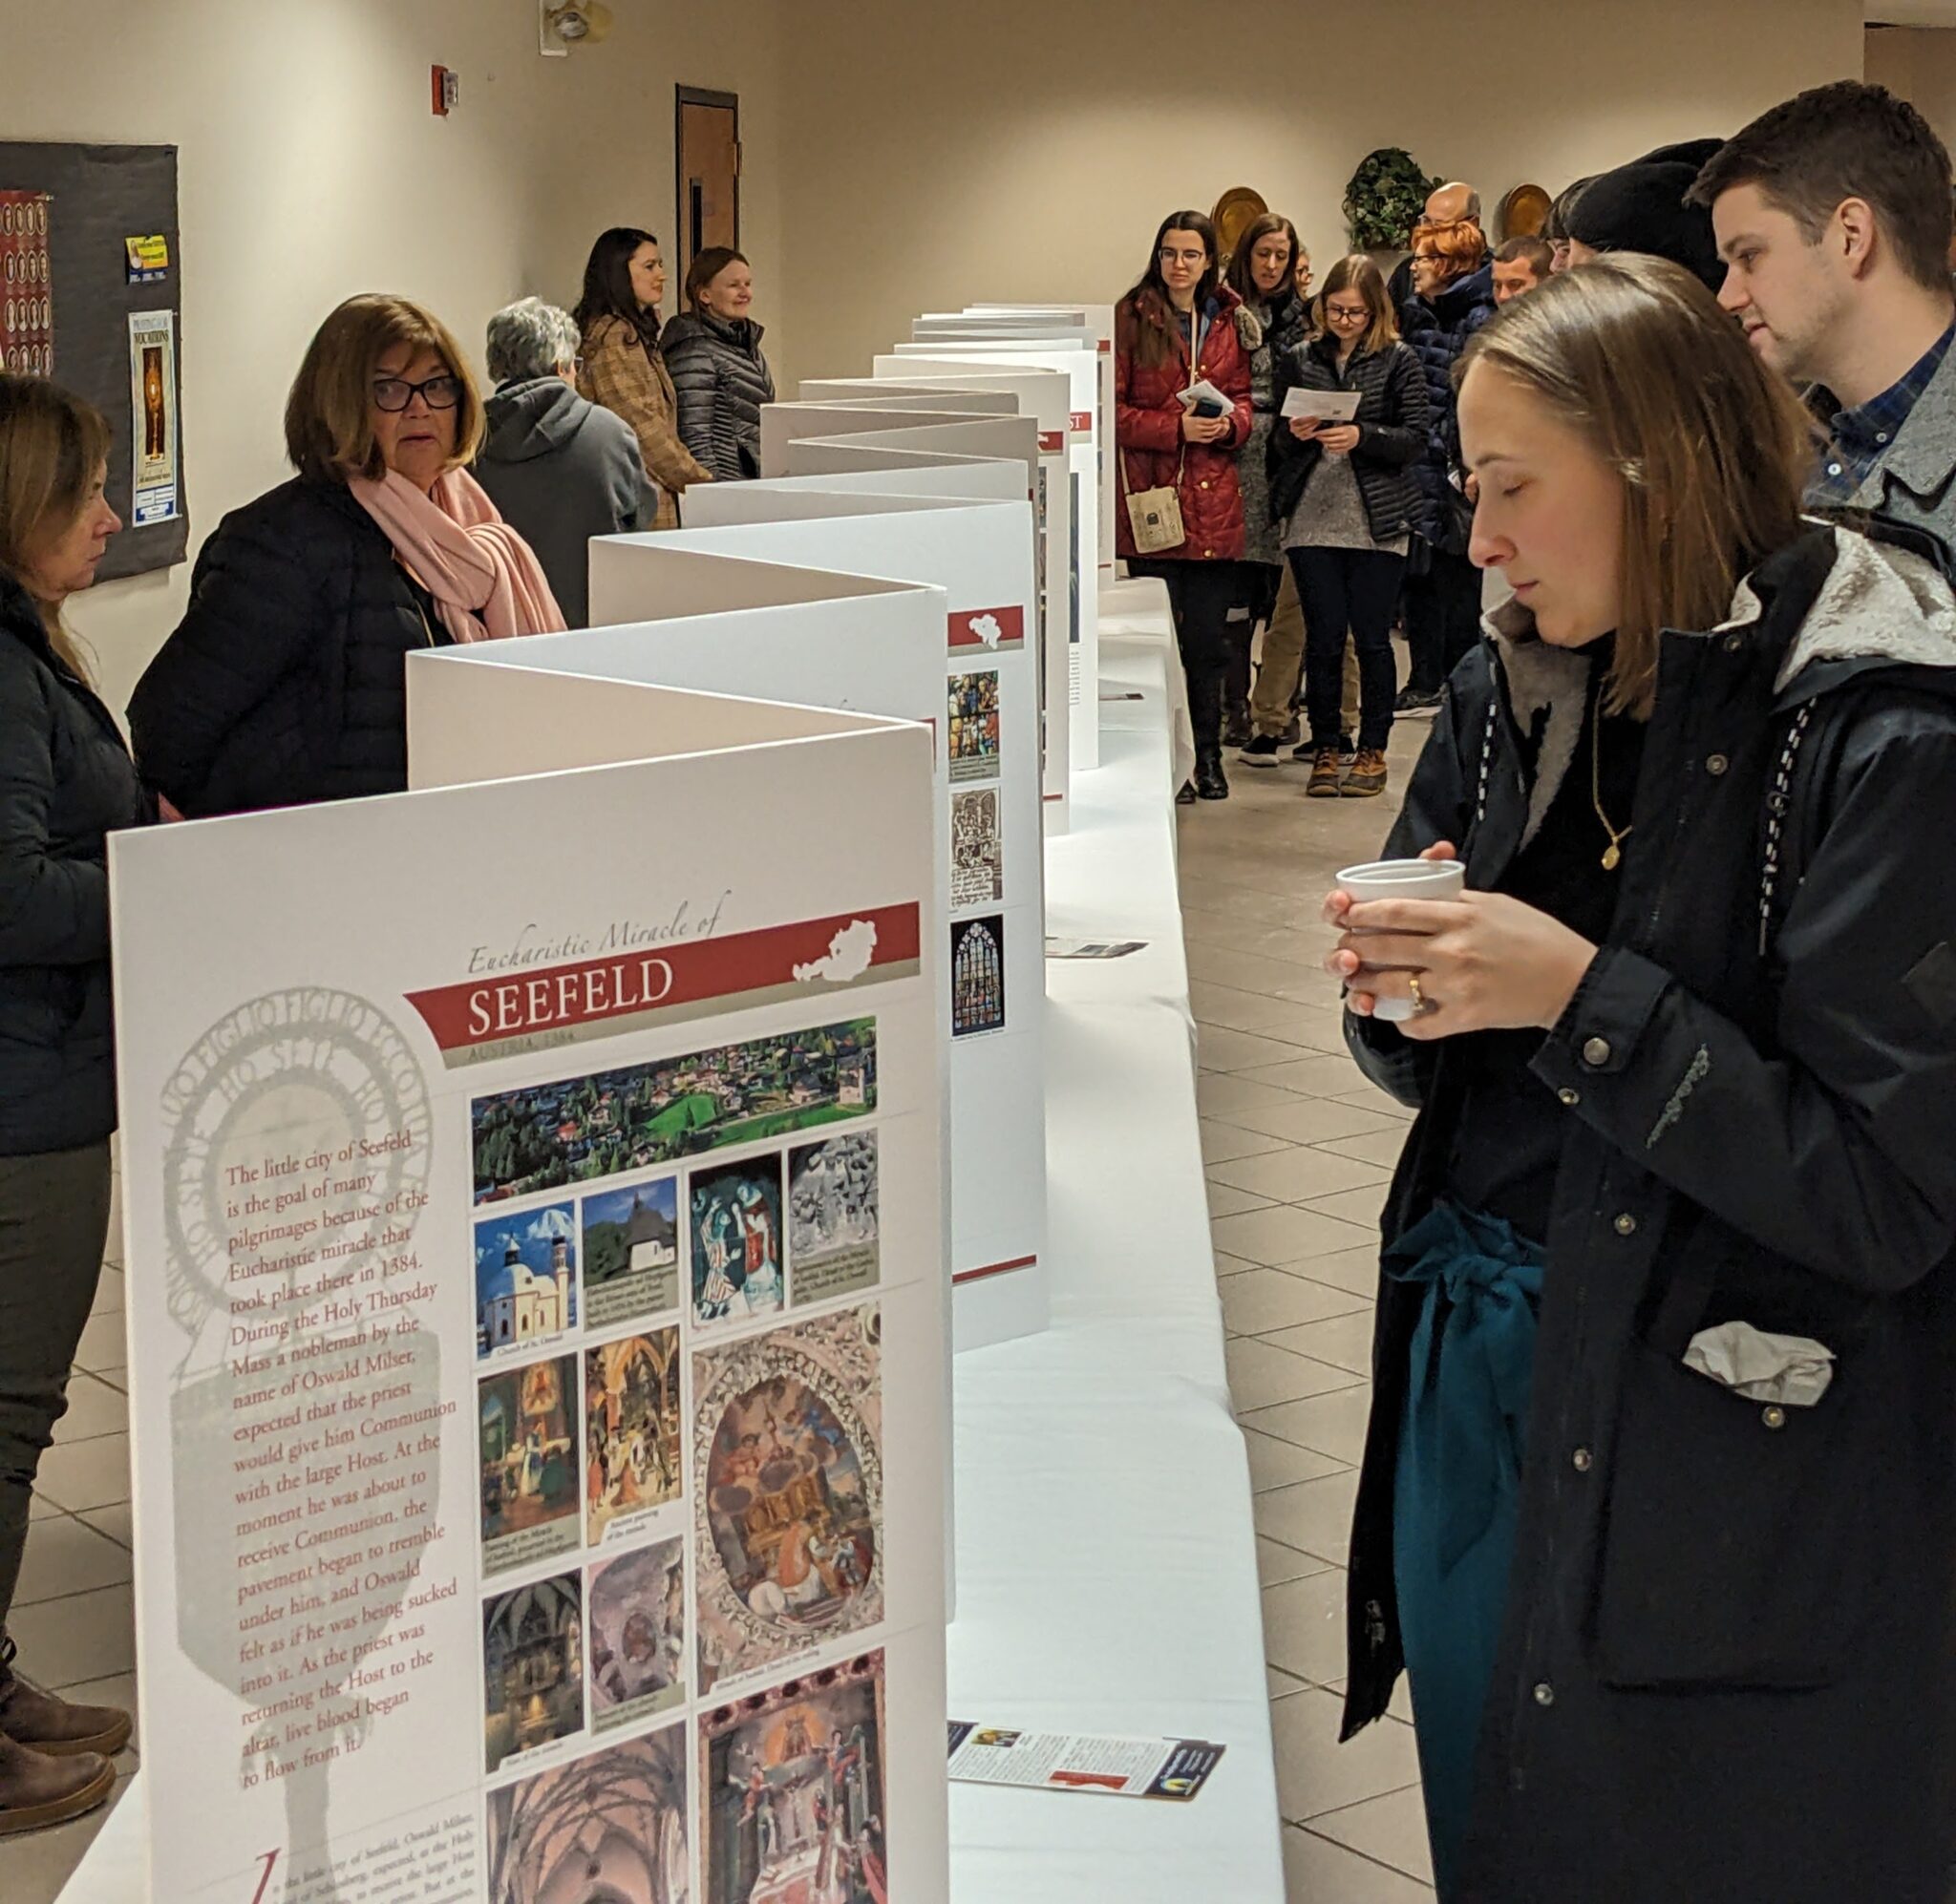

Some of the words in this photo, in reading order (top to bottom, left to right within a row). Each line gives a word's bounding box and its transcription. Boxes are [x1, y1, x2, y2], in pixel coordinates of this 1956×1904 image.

[467, 922, 590, 975] Eucharistic
[599, 899, 689, 955] Miracle
[697, 889, 733, 937] of
[467, 958, 673, 1036] SEEFELD
[225, 1165, 259, 1186] The
[265, 1154, 300, 1179] little
[306, 1149, 332, 1171] city
[338, 1141, 356, 1161] of
[358, 1130, 412, 1158] Seefeld
[227, 1200, 239, 1218] is
[244, 1194, 271, 1215] the
[275, 1183, 307, 1214] goal
[312, 1177, 331, 1199] of
[333, 1174, 376, 1194] many
[228, 1218, 317, 1256] pilgrimages
[323, 1201, 381, 1229] because
[385, 1191, 404, 1215] of
[406, 1189, 429, 1210] the
[229, 1248, 315, 1282] Eucharistic
[321, 1233, 376, 1260] miracle
[382, 1225, 412, 1244] that
[230, 1289, 266, 1315] took
[271, 1282, 311, 1310] place
[316, 1272, 354, 1293] there
[360, 1265, 374, 1282] in
[231, 1319, 289, 1346] During
[294, 1308, 319, 1331] the
[324, 1299, 363, 1323] Holy
[366, 1280, 438, 1313] Thursday
[232, 1356, 271, 1378] Mass
[277, 1354, 285, 1366] a
[290, 1332, 367, 1364] nobleman
[372, 1322, 391, 1344] by
[395, 1315, 419, 1335] the
[233, 1389, 275, 1410] name
[281, 1374, 300, 1395] of
[302, 1359, 360, 1390] Oswald
[233, 1406, 301, 1443] expected
[307, 1400, 337, 1422] that
[343, 1390, 366, 1412] the
[371, 1381, 413, 1409] priest
[233, 1442, 284, 1472] would
[288, 1434, 320, 1464] give
[324, 1428, 355, 1449] him
[360, 1400, 457, 1438] Communion
[235, 1483, 270, 1505] with
[276, 1472, 301, 1493] the
[306, 1463, 342, 1486] large
[393, 1440, 412, 1460] At
[417, 1432, 441, 1454] the
[236, 1506, 303, 1536] moment
[308, 1496, 326, 1515] he
[331, 1490, 359, 1508] was
[364, 1477, 406, 1500] about
[411, 1470, 427, 1487] to
[237, 1542, 290, 1568] receive
[404, 1497, 428, 1518] the
[237, 1565, 313, 1606] pavement
[318, 1549, 363, 1575] began
[368, 1541, 383, 1558] to
[389, 1521, 446, 1554] tremble
[239, 1603, 285, 1631] under
[330, 1576, 359, 1602] and
[364, 1557, 420, 1592] Oswald
[239, 1640, 266, 1663] felt
[269, 1637, 285, 1654] as
[289, 1624, 306, 1647] if
[307, 1621, 326, 1641] he
[330, 1615, 358, 1634] was
[362, 1599, 403, 1623] being
[408, 1576, 457, 1611] sucked
[240, 1672, 273, 1695] into
[298, 1656, 319, 1676] As
[324, 1647, 348, 1669] the
[352, 1634, 393, 1662] priest
[397, 1621, 426, 1642] was
[241, 1692, 315, 1726] returning
[319, 1679, 342, 1701] the
[348, 1665, 386, 1691] Host
[390, 1659, 406, 1676] to
[410, 1648, 435, 1670] the
[286, 1720, 312, 1743] live
[316, 1701, 360, 1732] blood
[365, 1689, 410, 1716] began
[243, 1771, 259, 1788] to
[264, 1757, 298, 1782] flow
[303, 1743, 340, 1767] from
